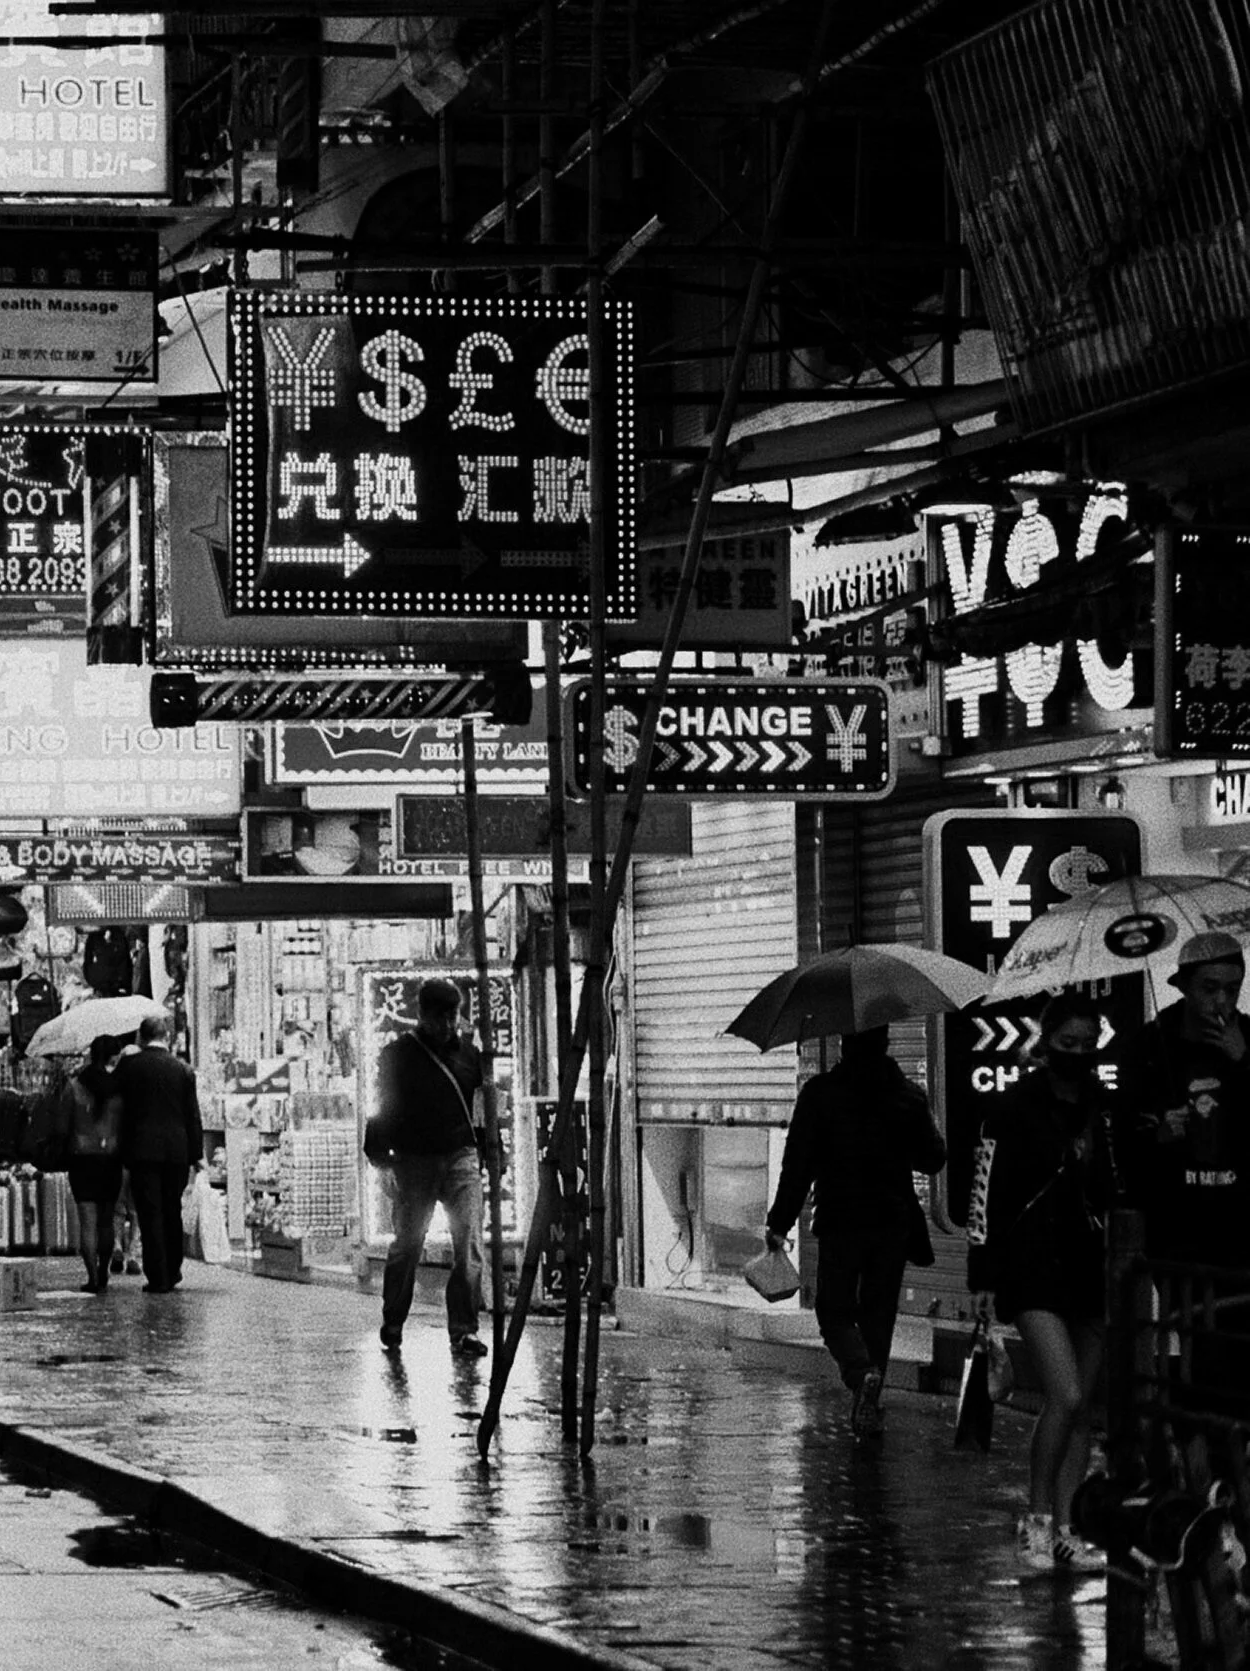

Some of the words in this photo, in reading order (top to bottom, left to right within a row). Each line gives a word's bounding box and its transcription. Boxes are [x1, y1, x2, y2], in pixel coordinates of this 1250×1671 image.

[20, 79, 155, 107] HOTEL
[46, 299, 119, 315] Massage
[358, 329, 427, 432] $
[448, 331, 516, 431] £
[535, 334, 590, 434] €
[103, 727, 230, 753] HOTEL
[824, 704, 867, 772] ¥
[17, 845, 88, 866] BODY
[91, 844, 212, 867] MASSAGE
[378, 861, 445, 875] HOTEL
[459, 861, 510, 875] FEE
[967, 846, 1033, 938] ¥
